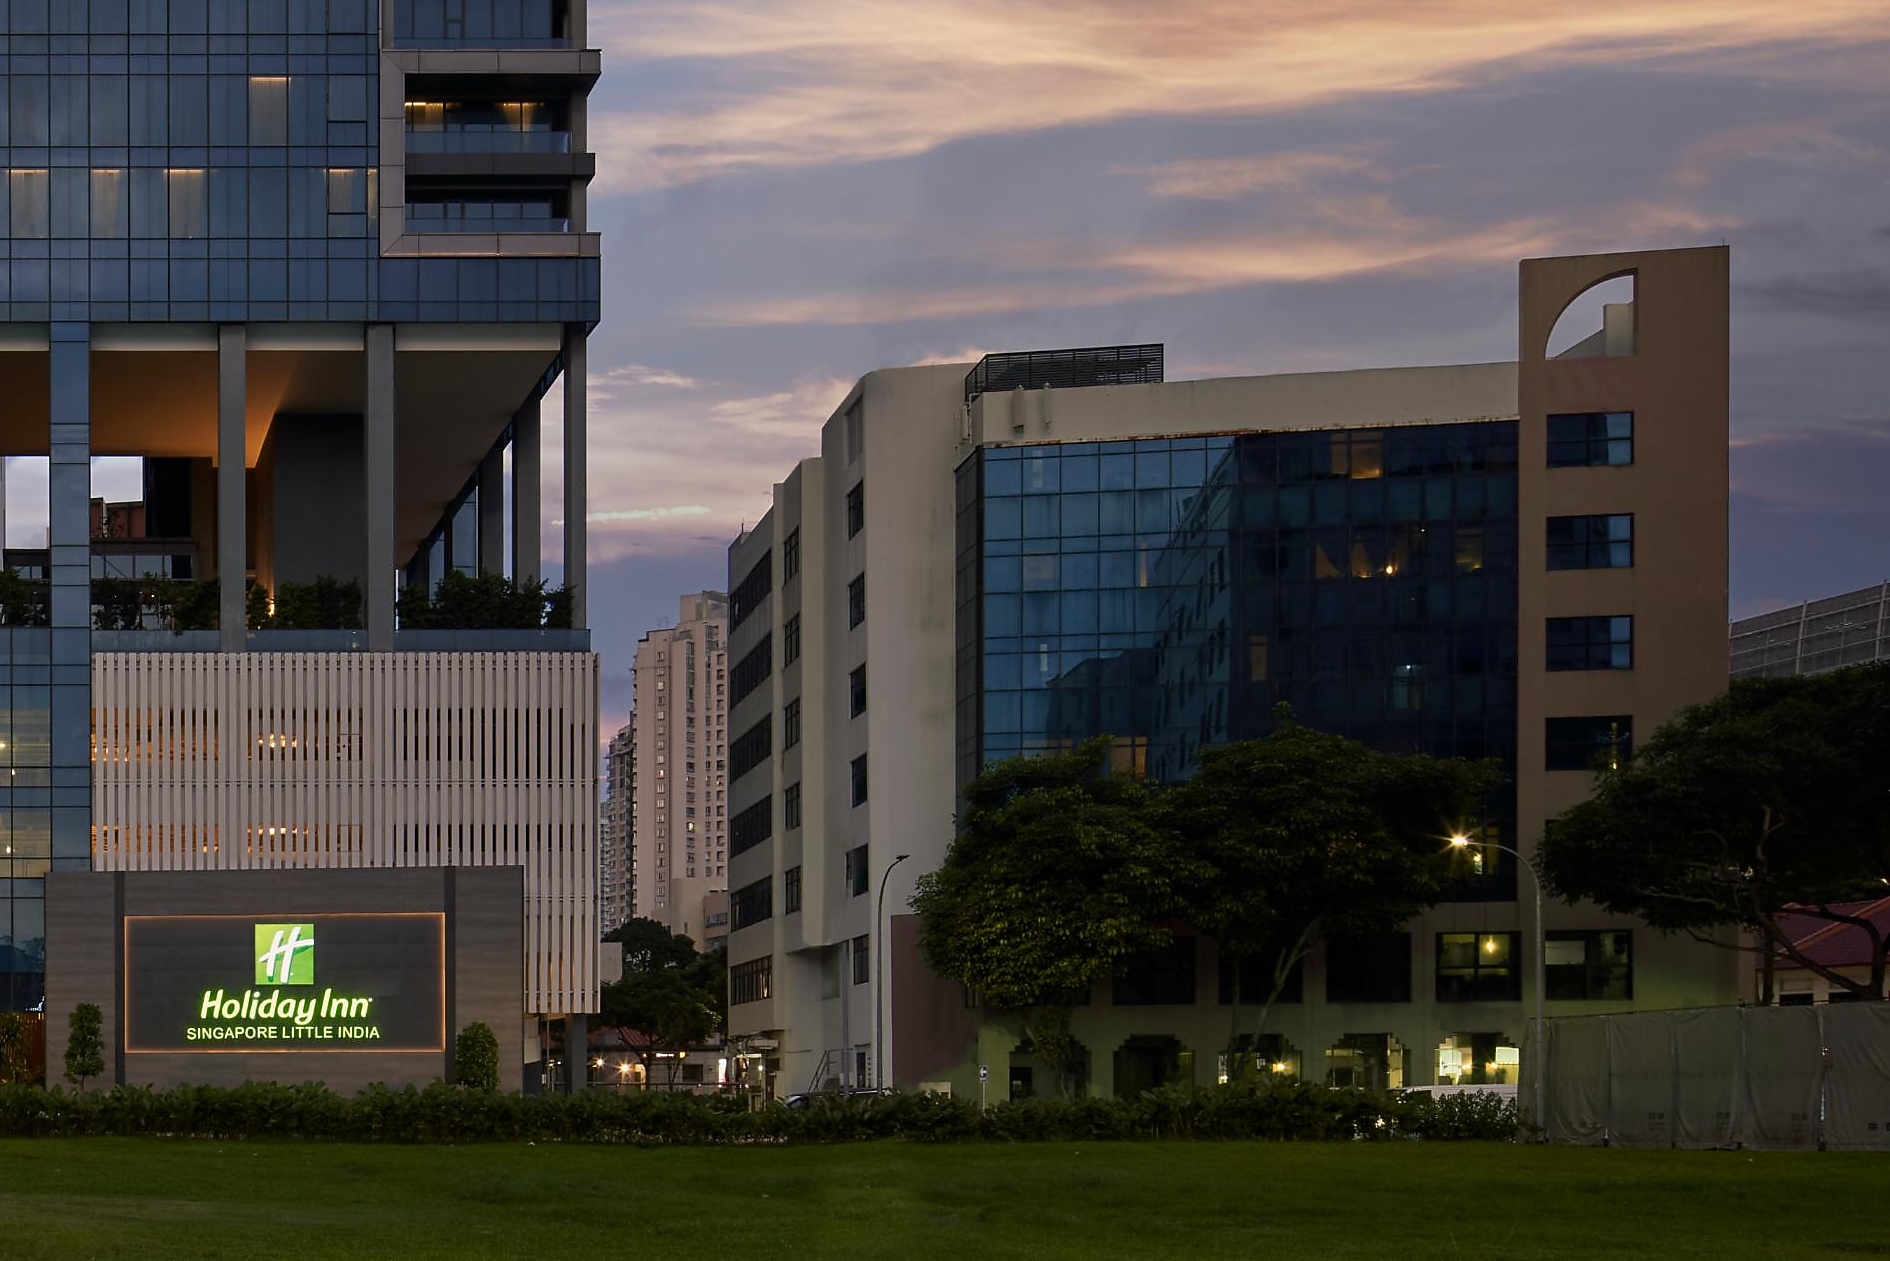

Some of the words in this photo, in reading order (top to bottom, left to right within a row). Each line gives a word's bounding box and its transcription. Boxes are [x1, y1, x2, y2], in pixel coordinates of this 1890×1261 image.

[200, 989, 316, 1026] Holiday
[320, 988, 370, 1018] Inn
[186, 1026, 278, 1040] SINGAPORE
[282, 1026, 333, 1039] LITTLE
[337, 1026, 380, 1039] INDIA
